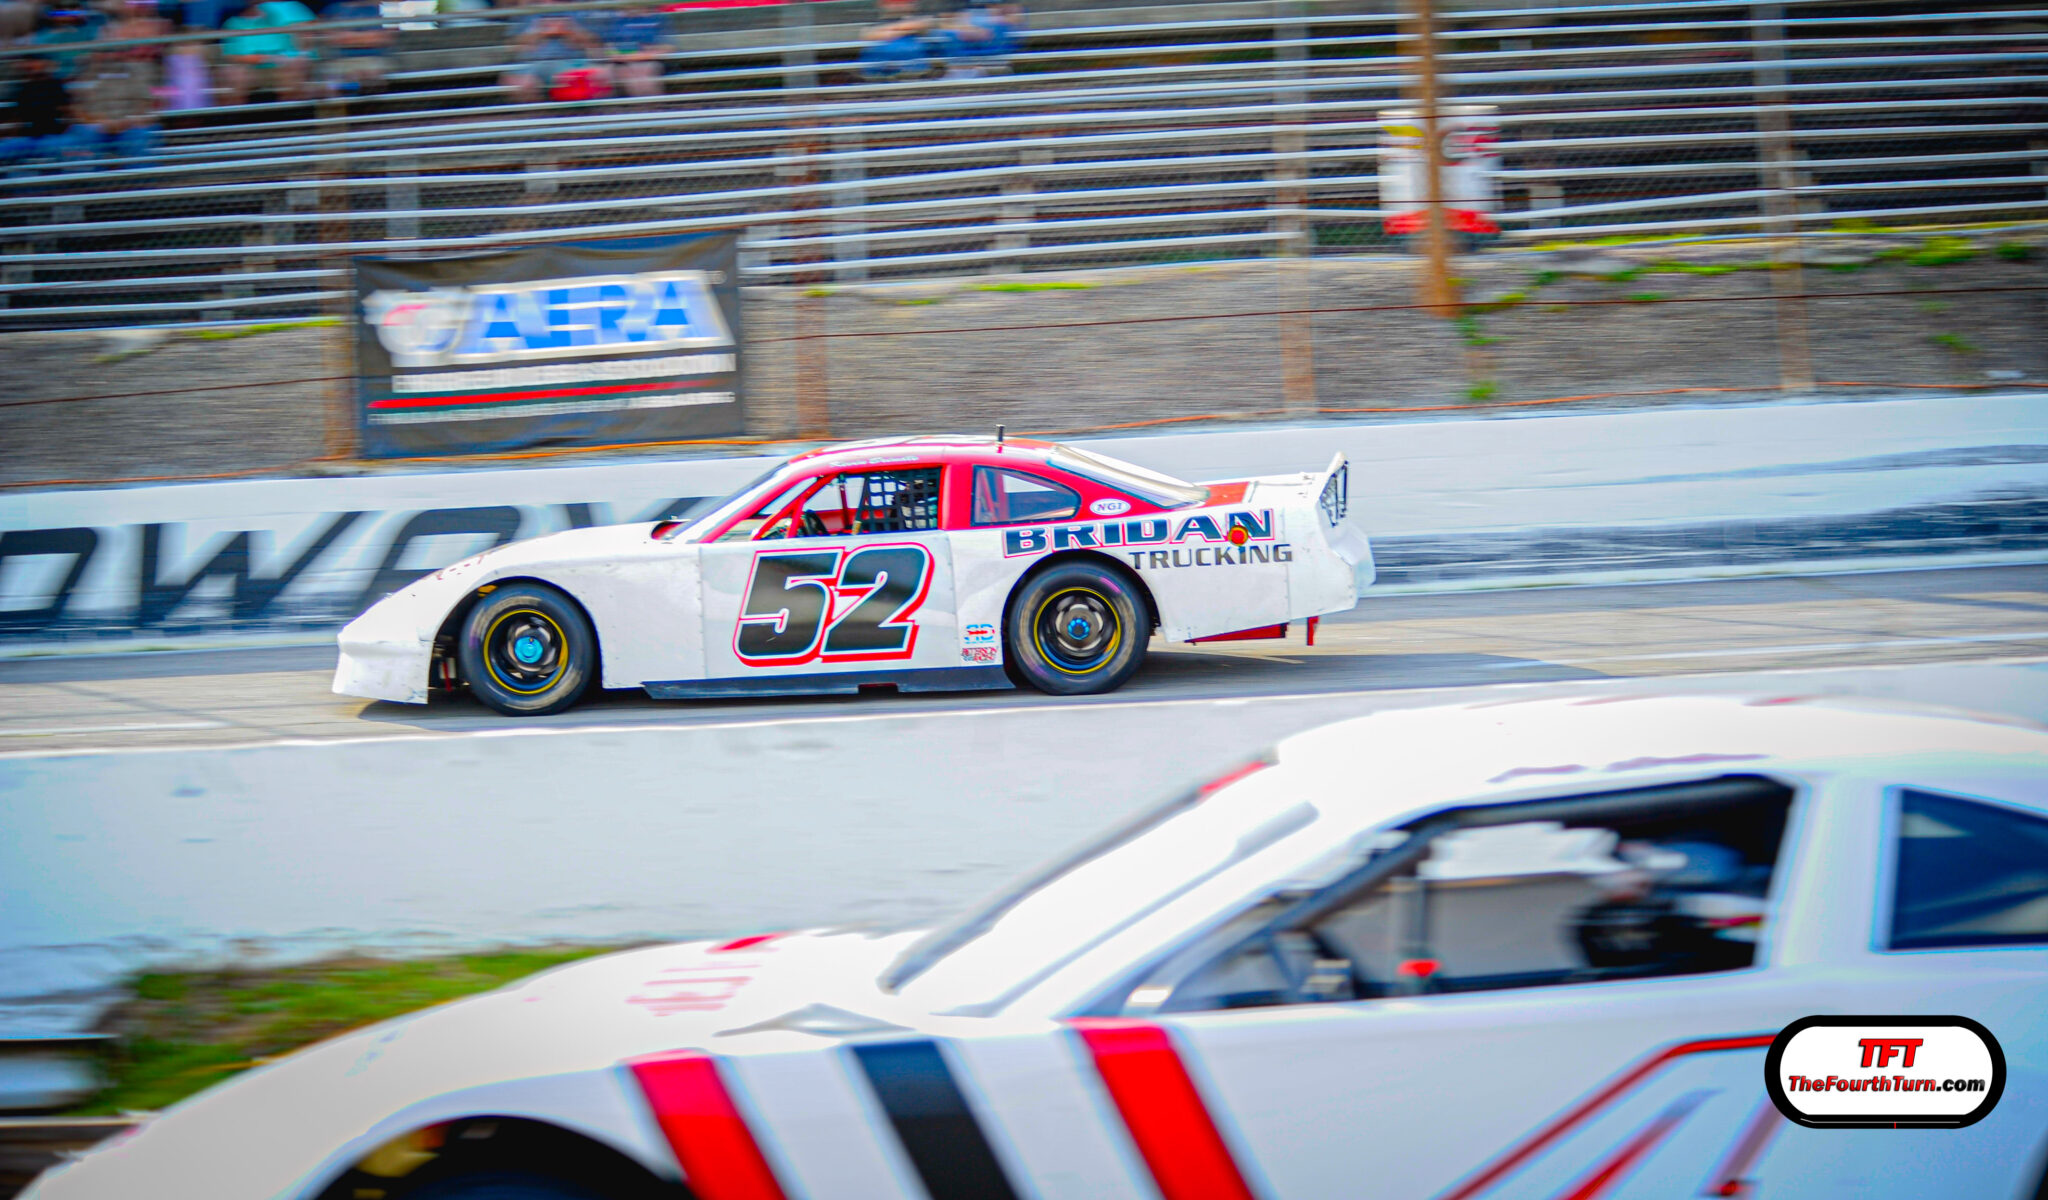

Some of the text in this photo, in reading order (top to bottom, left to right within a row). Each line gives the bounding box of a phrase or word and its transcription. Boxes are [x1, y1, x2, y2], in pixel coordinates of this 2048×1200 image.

[1002, 508, 1275, 558] BRIDAN
[1129, 544, 1293, 569] TRUCKING
[733, 541, 935, 667] 52
